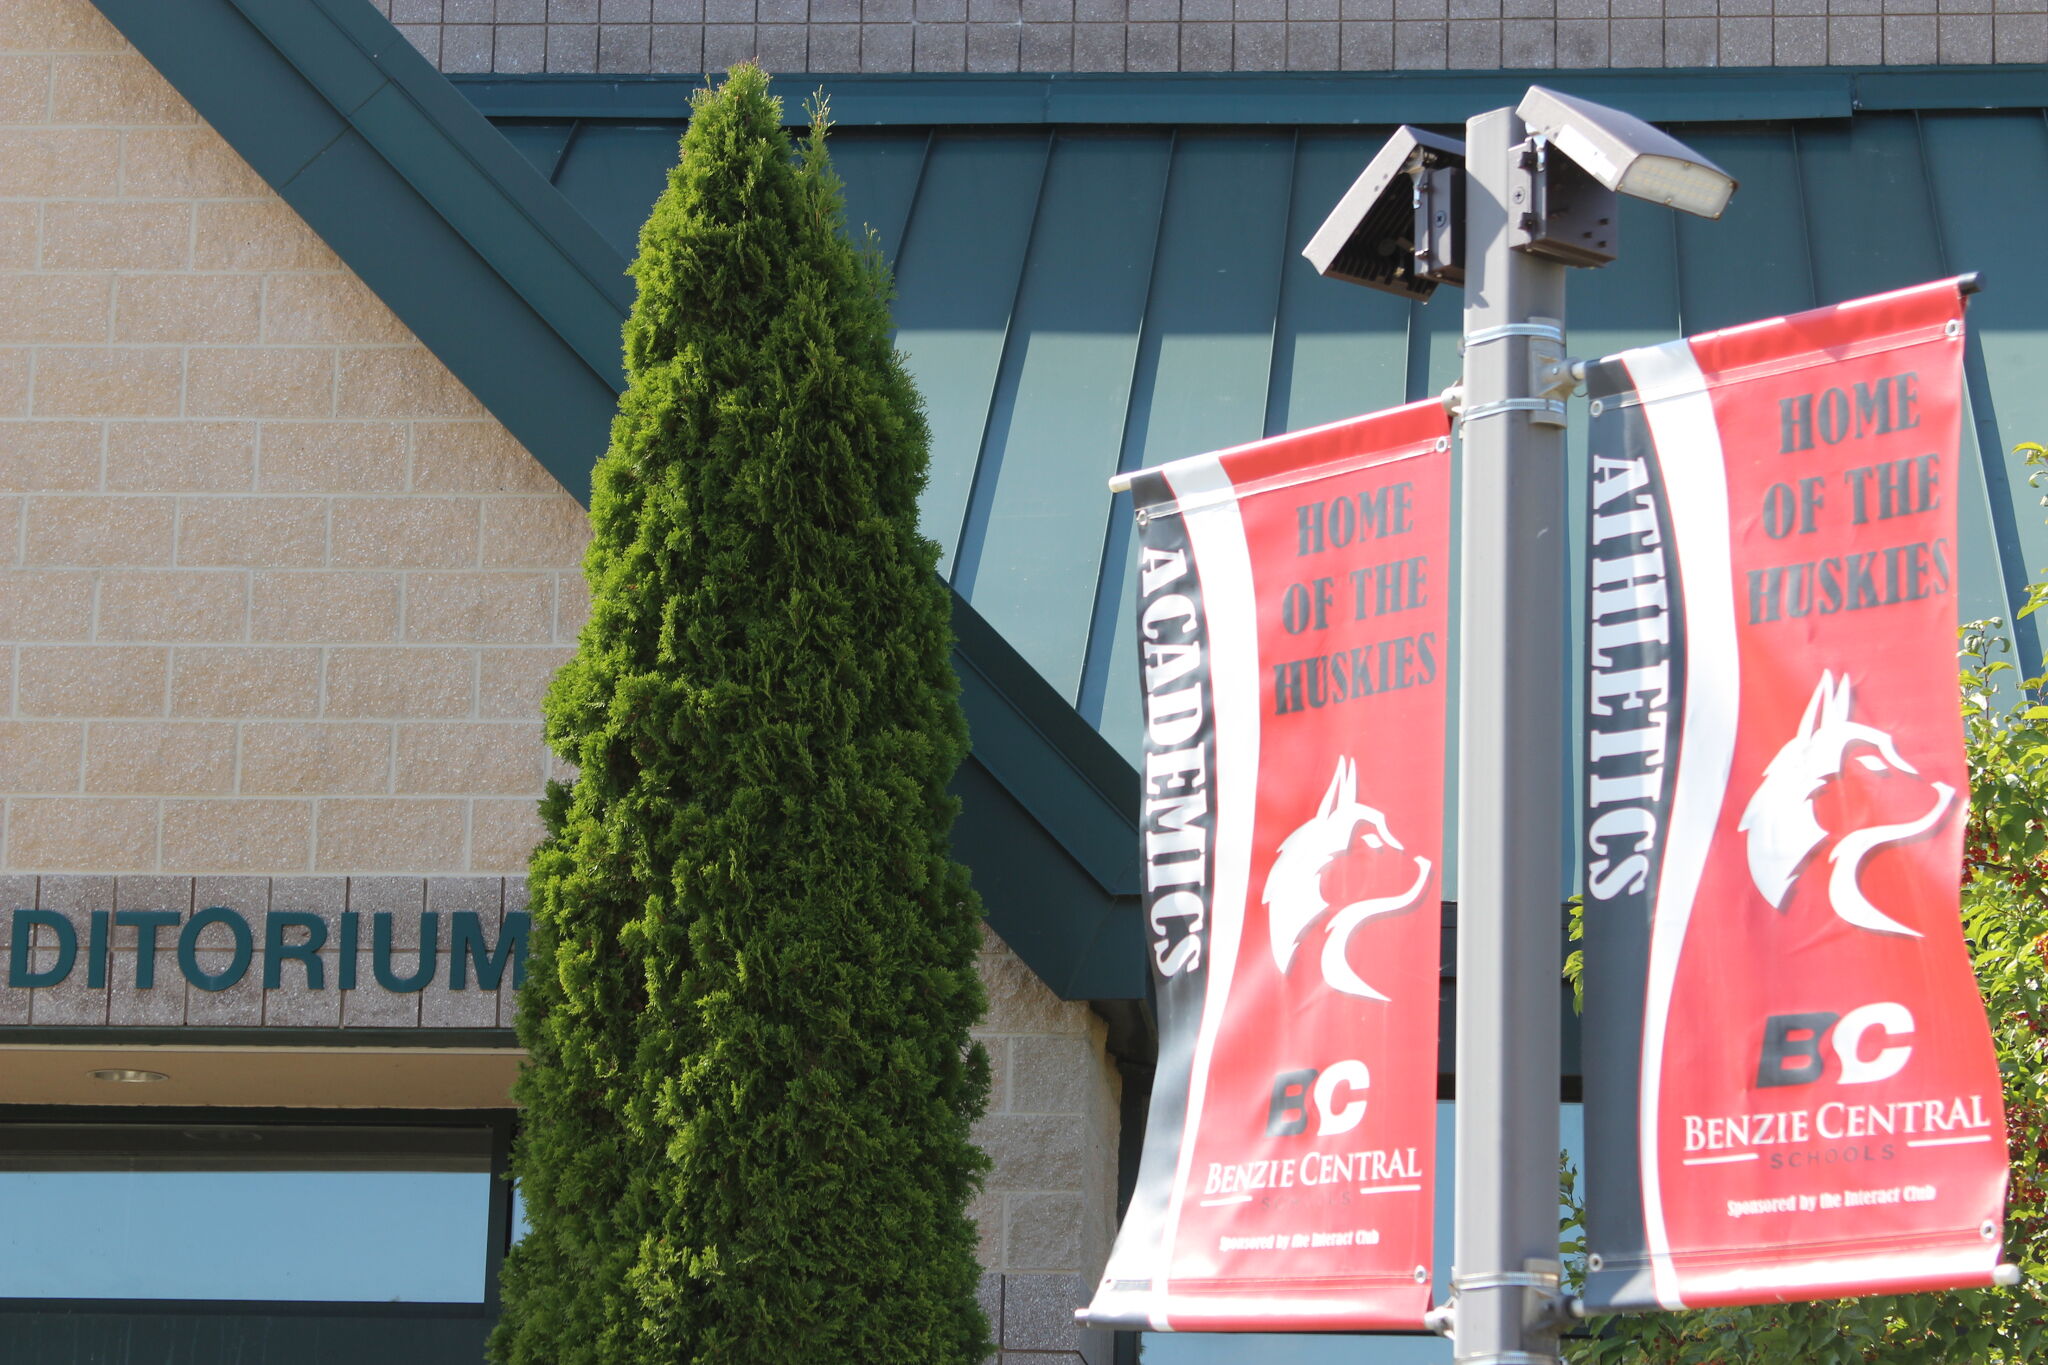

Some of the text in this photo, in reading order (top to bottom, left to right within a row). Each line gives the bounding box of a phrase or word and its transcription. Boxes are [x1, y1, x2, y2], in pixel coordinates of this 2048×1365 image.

[1780, 372, 1920, 454] HOME
[1296, 482, 1413, 557] HOME
[1762, 453, 1941, 541] OF THE
[1282, 556, 1428, 635] OF THE
[1746, 538, 1950, 626] HUSKIES
[1273, 632, 1436, 715] HUSKIES
[1589, 454, 1669, 901] ATHLETICS
[1141, 547, 1205, 978] ACADEMICS
[8, 907, 532, 993] DITORIUM
[1756, 1002, 1915, 1089] BC
[1264, 1059, 1370, 1137] BC
[1683, 1095, 1992, 1152] BENZIE CENTRAL
[1204, 1148, 1422, 1195] BENZIE CENTRAL
[1770, 1144, 1895, 1170] SCHOOLS
[1727, 1184, 1937, 1218] Sponsored by the Interact Club
